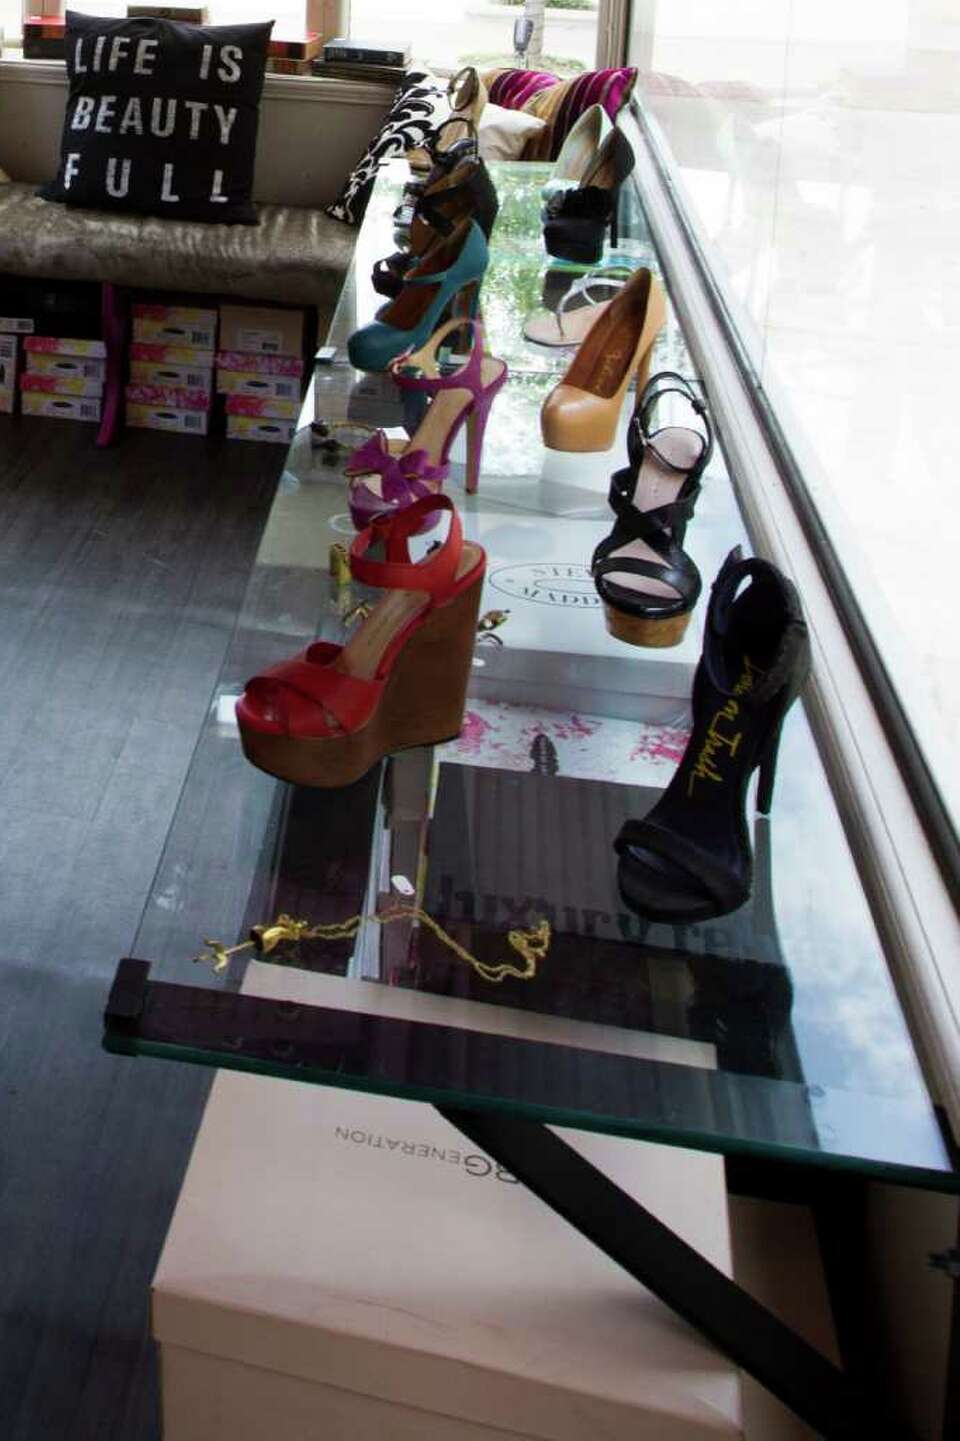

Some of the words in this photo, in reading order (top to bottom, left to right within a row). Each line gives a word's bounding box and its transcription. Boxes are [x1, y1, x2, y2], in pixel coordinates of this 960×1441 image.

[74, 35, 159, 75] LIFE
[199, 44, 243, 83] IS
[70, 95, 237, 145] BEAUTY
